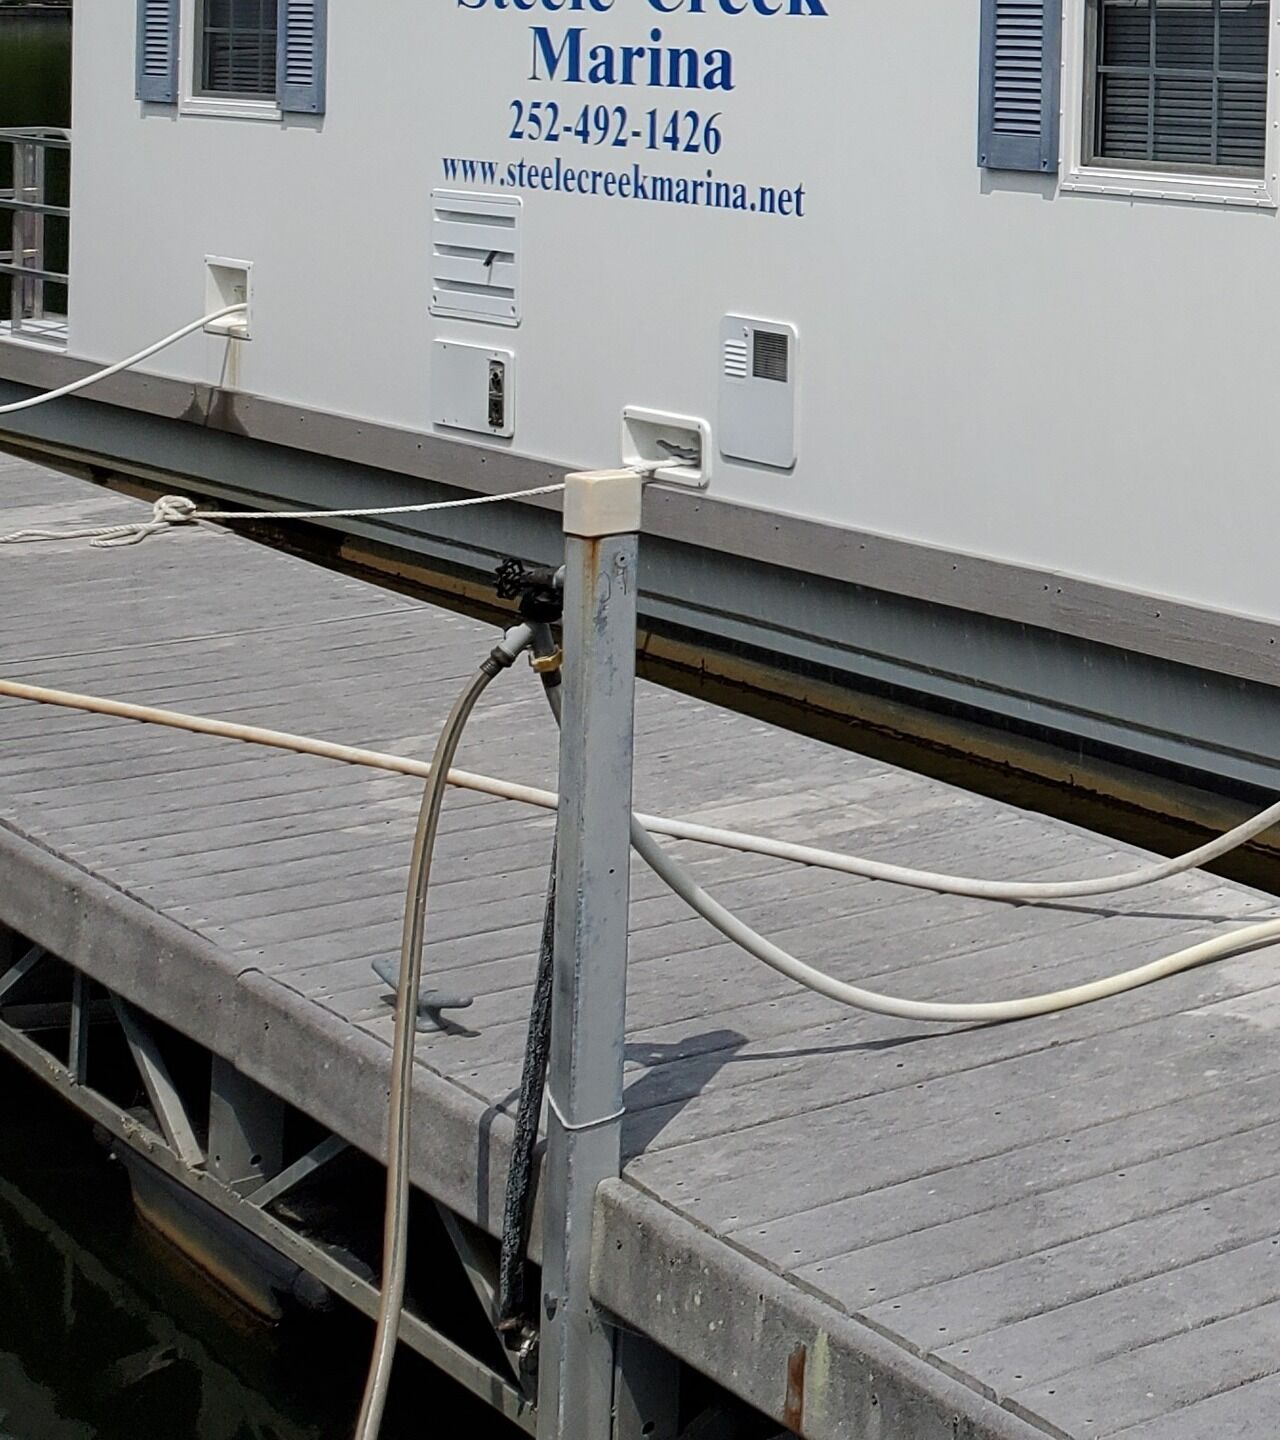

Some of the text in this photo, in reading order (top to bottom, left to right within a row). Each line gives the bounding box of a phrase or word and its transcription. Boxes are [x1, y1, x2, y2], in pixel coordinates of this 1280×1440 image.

[527, 25, 736, 91] Marina
[508, 99, 723, 155] 252-492-1426
[441, 156, 806, 217] www.steelecreekmarina.net
